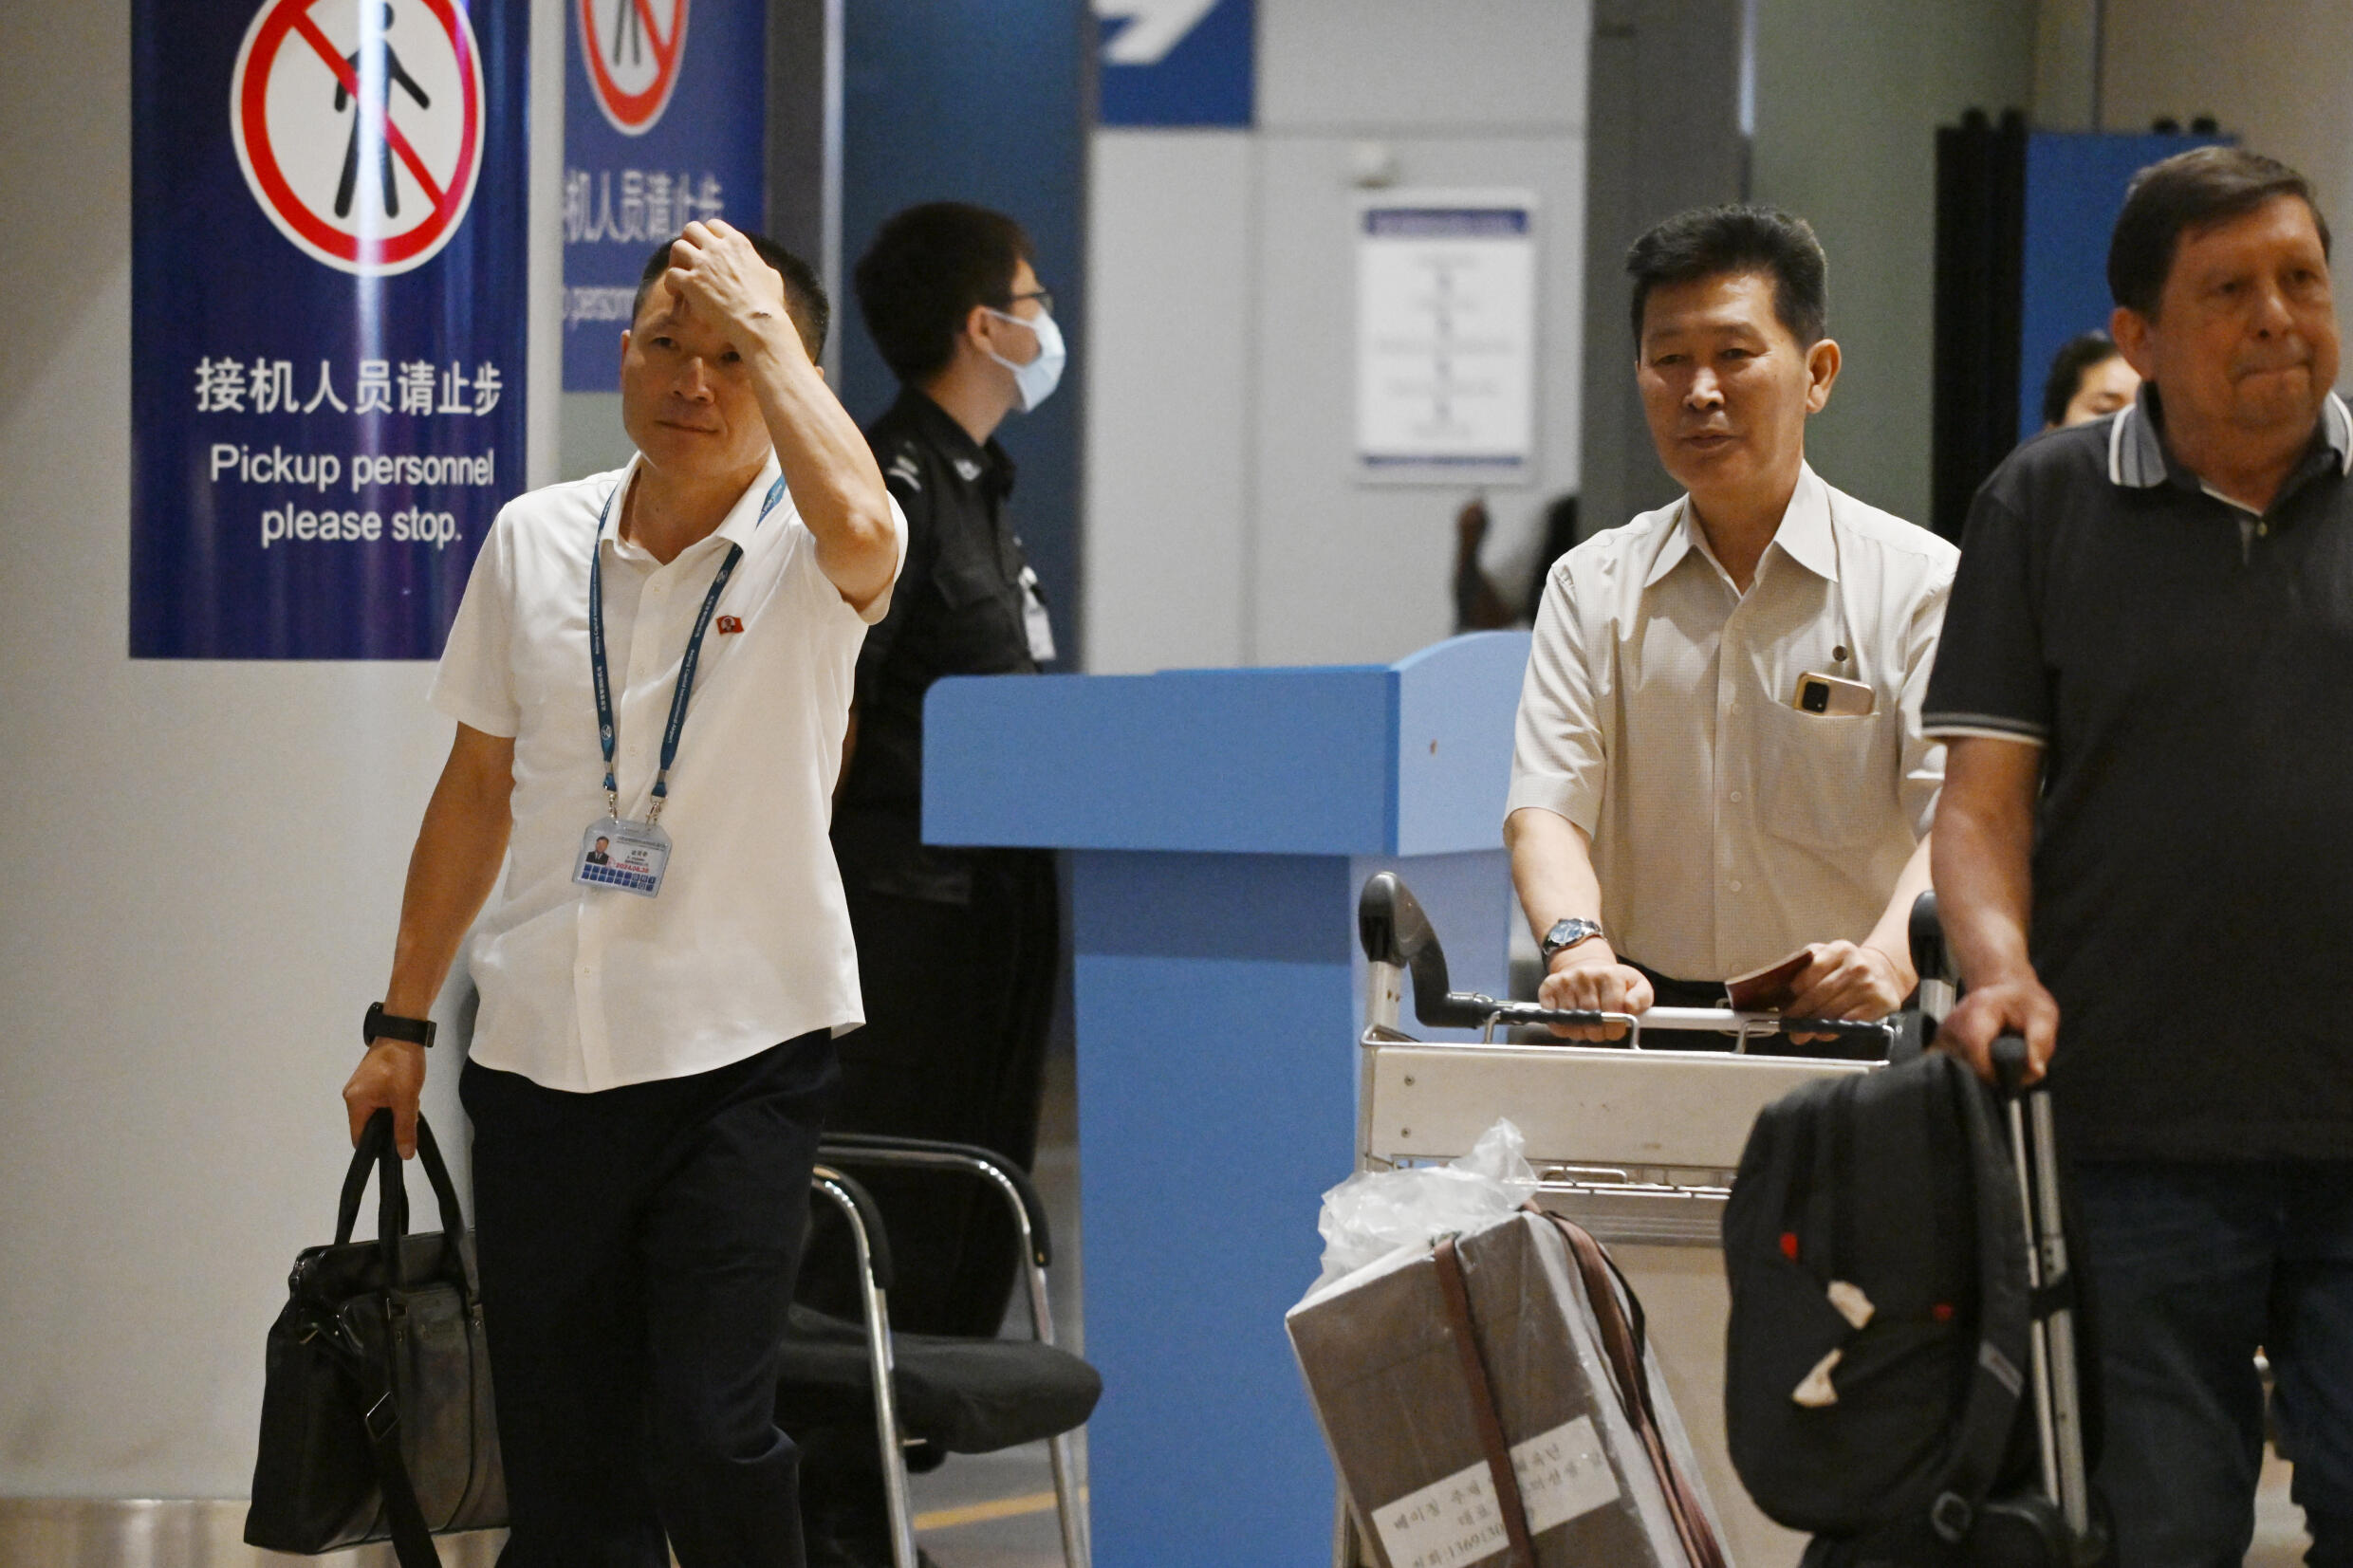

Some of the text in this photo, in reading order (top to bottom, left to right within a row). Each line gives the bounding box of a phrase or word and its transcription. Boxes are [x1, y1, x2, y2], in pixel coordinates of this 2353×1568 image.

[194, 356, 504, 417] 接机人员请止步
[210, 443, 494, 493] Pickup personnel
[261, 501, 463, 551] please stop.
